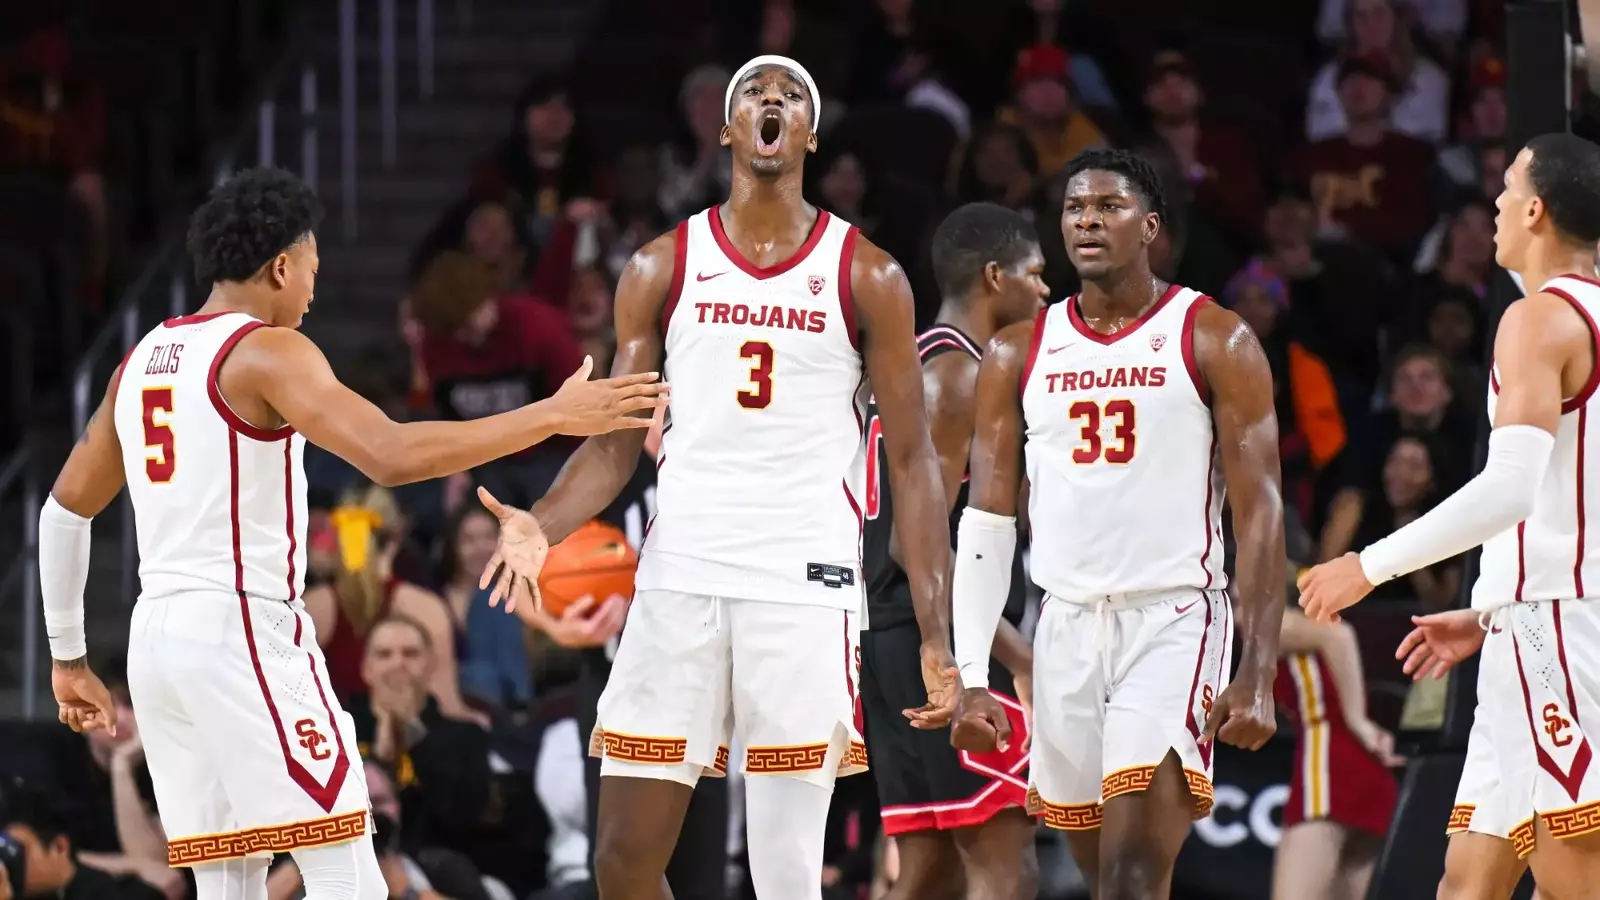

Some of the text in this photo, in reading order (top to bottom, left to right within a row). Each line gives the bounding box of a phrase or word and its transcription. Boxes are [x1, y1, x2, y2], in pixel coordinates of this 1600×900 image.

[694, 302, 827, 334] TROJANS
[145, 343, 184, 375] ELLIS
[736, 341, 775, 410] 3
[1045, 366, 1167, 394] TROJANS
[141, 386, 176, 484] 5
[1068, 398, 1137, 465] 33
[294, 718, 331, 761] SC
[1543, 703, 1573, 747] SC
